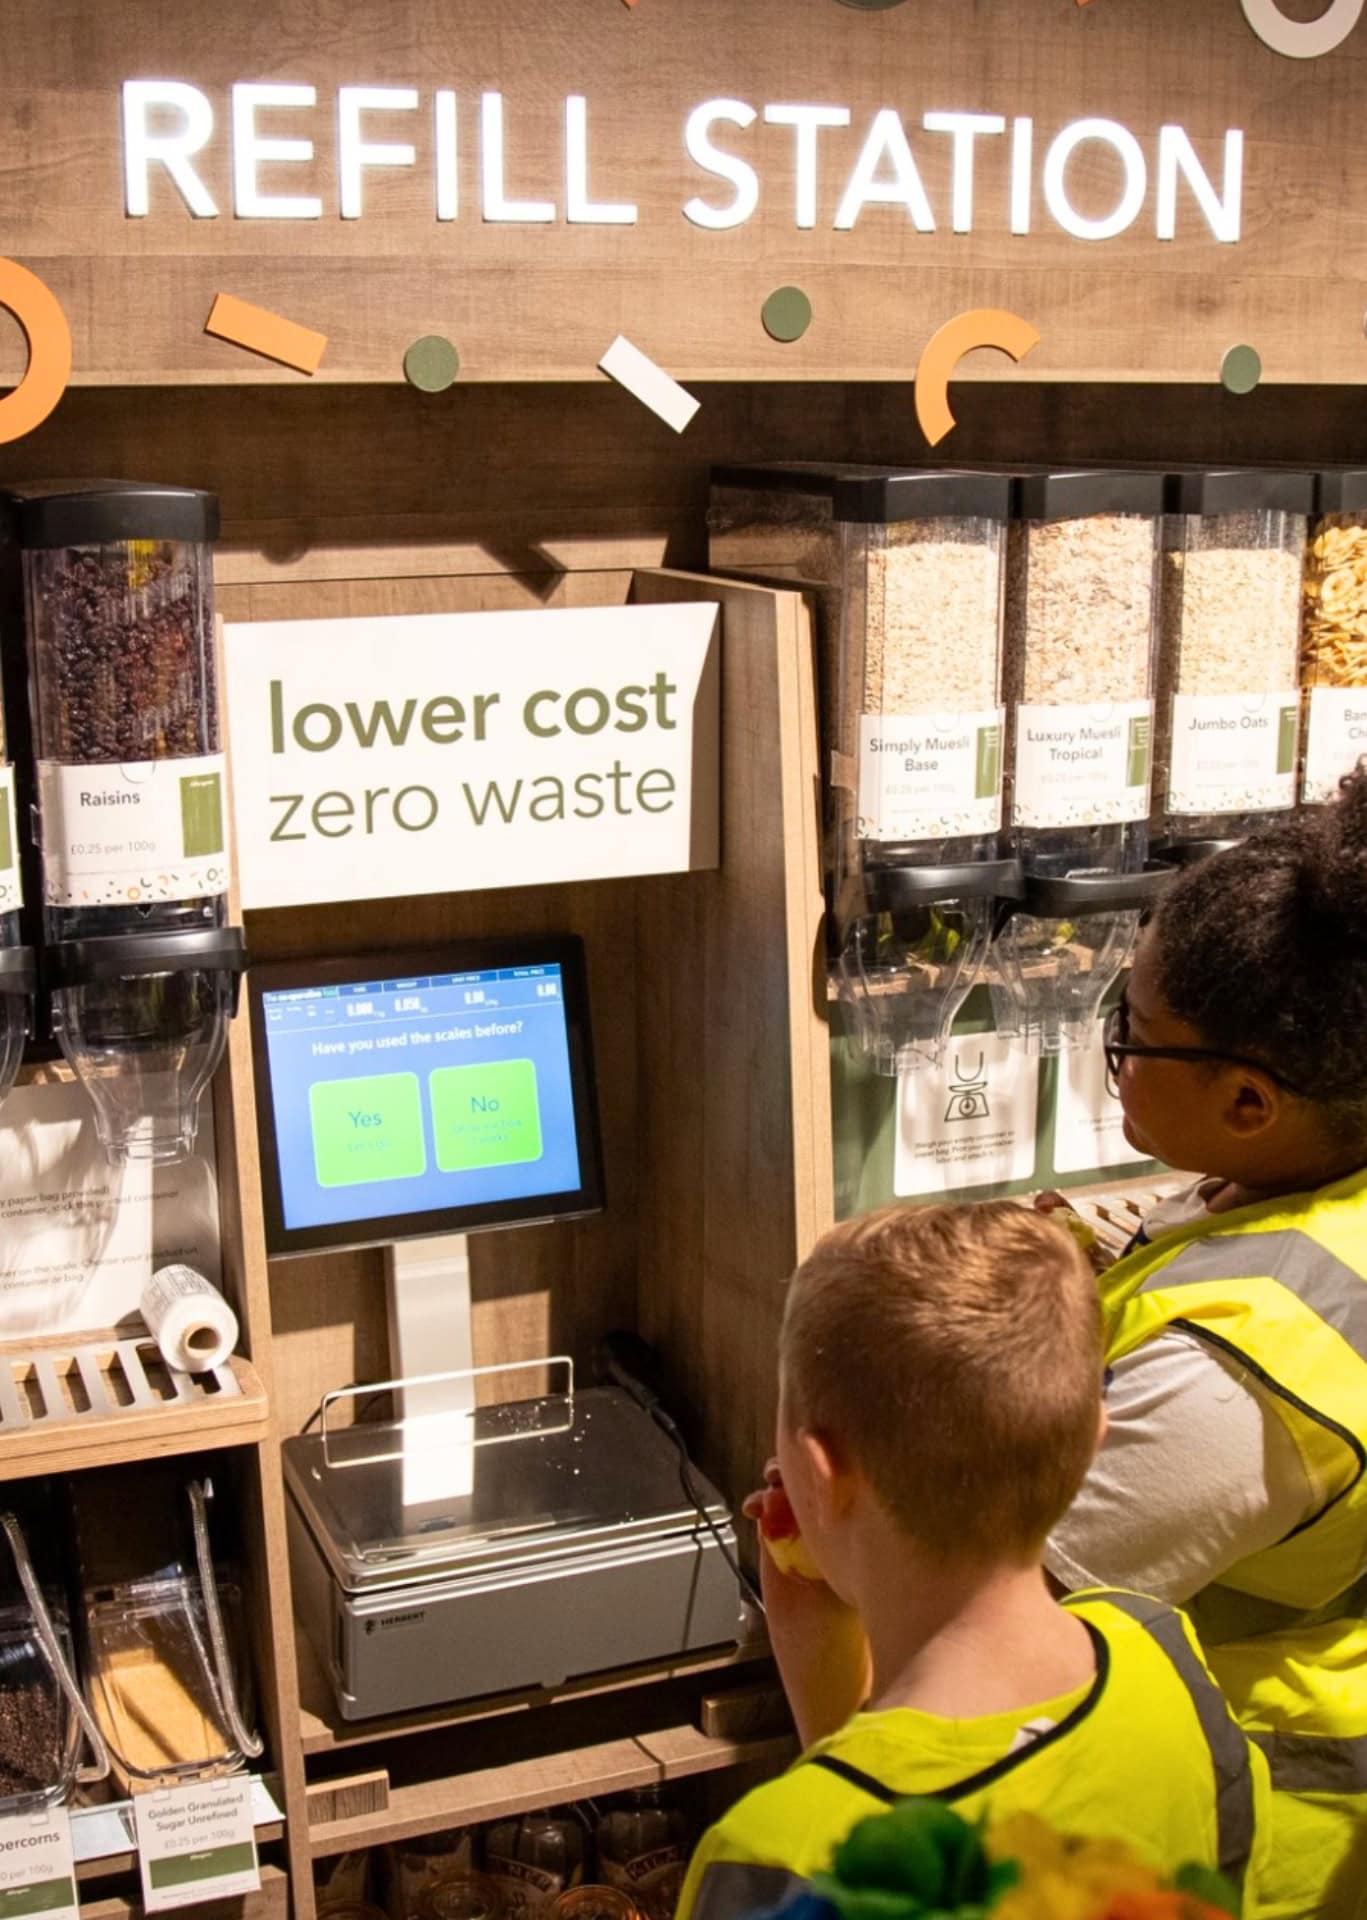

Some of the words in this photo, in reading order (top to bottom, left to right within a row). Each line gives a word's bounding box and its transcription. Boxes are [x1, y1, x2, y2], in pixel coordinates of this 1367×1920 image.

[122, 80, 638, 224] REFILL
[682, 98, 1244, 244] STATION
[269, 679, 501, 754] lower
[522, 671, 678, 739] cost
[1187, 716, 1237, 731] Jumbo
[1240, 714, 1269, 729] Oats
[1026, 727, 1075, 745] Luxury
[1080, 725, 1120, 740] Muesli
[869, 737, 922, 755] Simply
[925, 736, 970, 751] Muesli
[1048, 746, 1103, 764] Tropical
[904, 758, 939, 772] Base
[79, 790, 141, 807] Raisins
[269, 784, 439, 842] zero
[461, 760, 677, 825] waste
[70, 843, 102, 856] £0.25
[104, 843, 124, 855] per
[127, 840, 156, 853] 100g
[311, 1040, 346, 1056] Have
[348, 1039, 373, 1055] you
[376, 1031, 408, 1049] used
[410, 1030, 432, 1045] the
[434, 1024, 473, 1042] scales
[474, 1020, 524, 1038] before?
[470, 1095, 500, 1113] No
[347, 1111, 383, 1129] Yes
[148, 1805, 186, 1820] Golden
[187, 1793, 245, 1813] Granulated
[155, 1817, 186, 1833] Sugar
[188, 1807, 239, 1825] Unrefined
